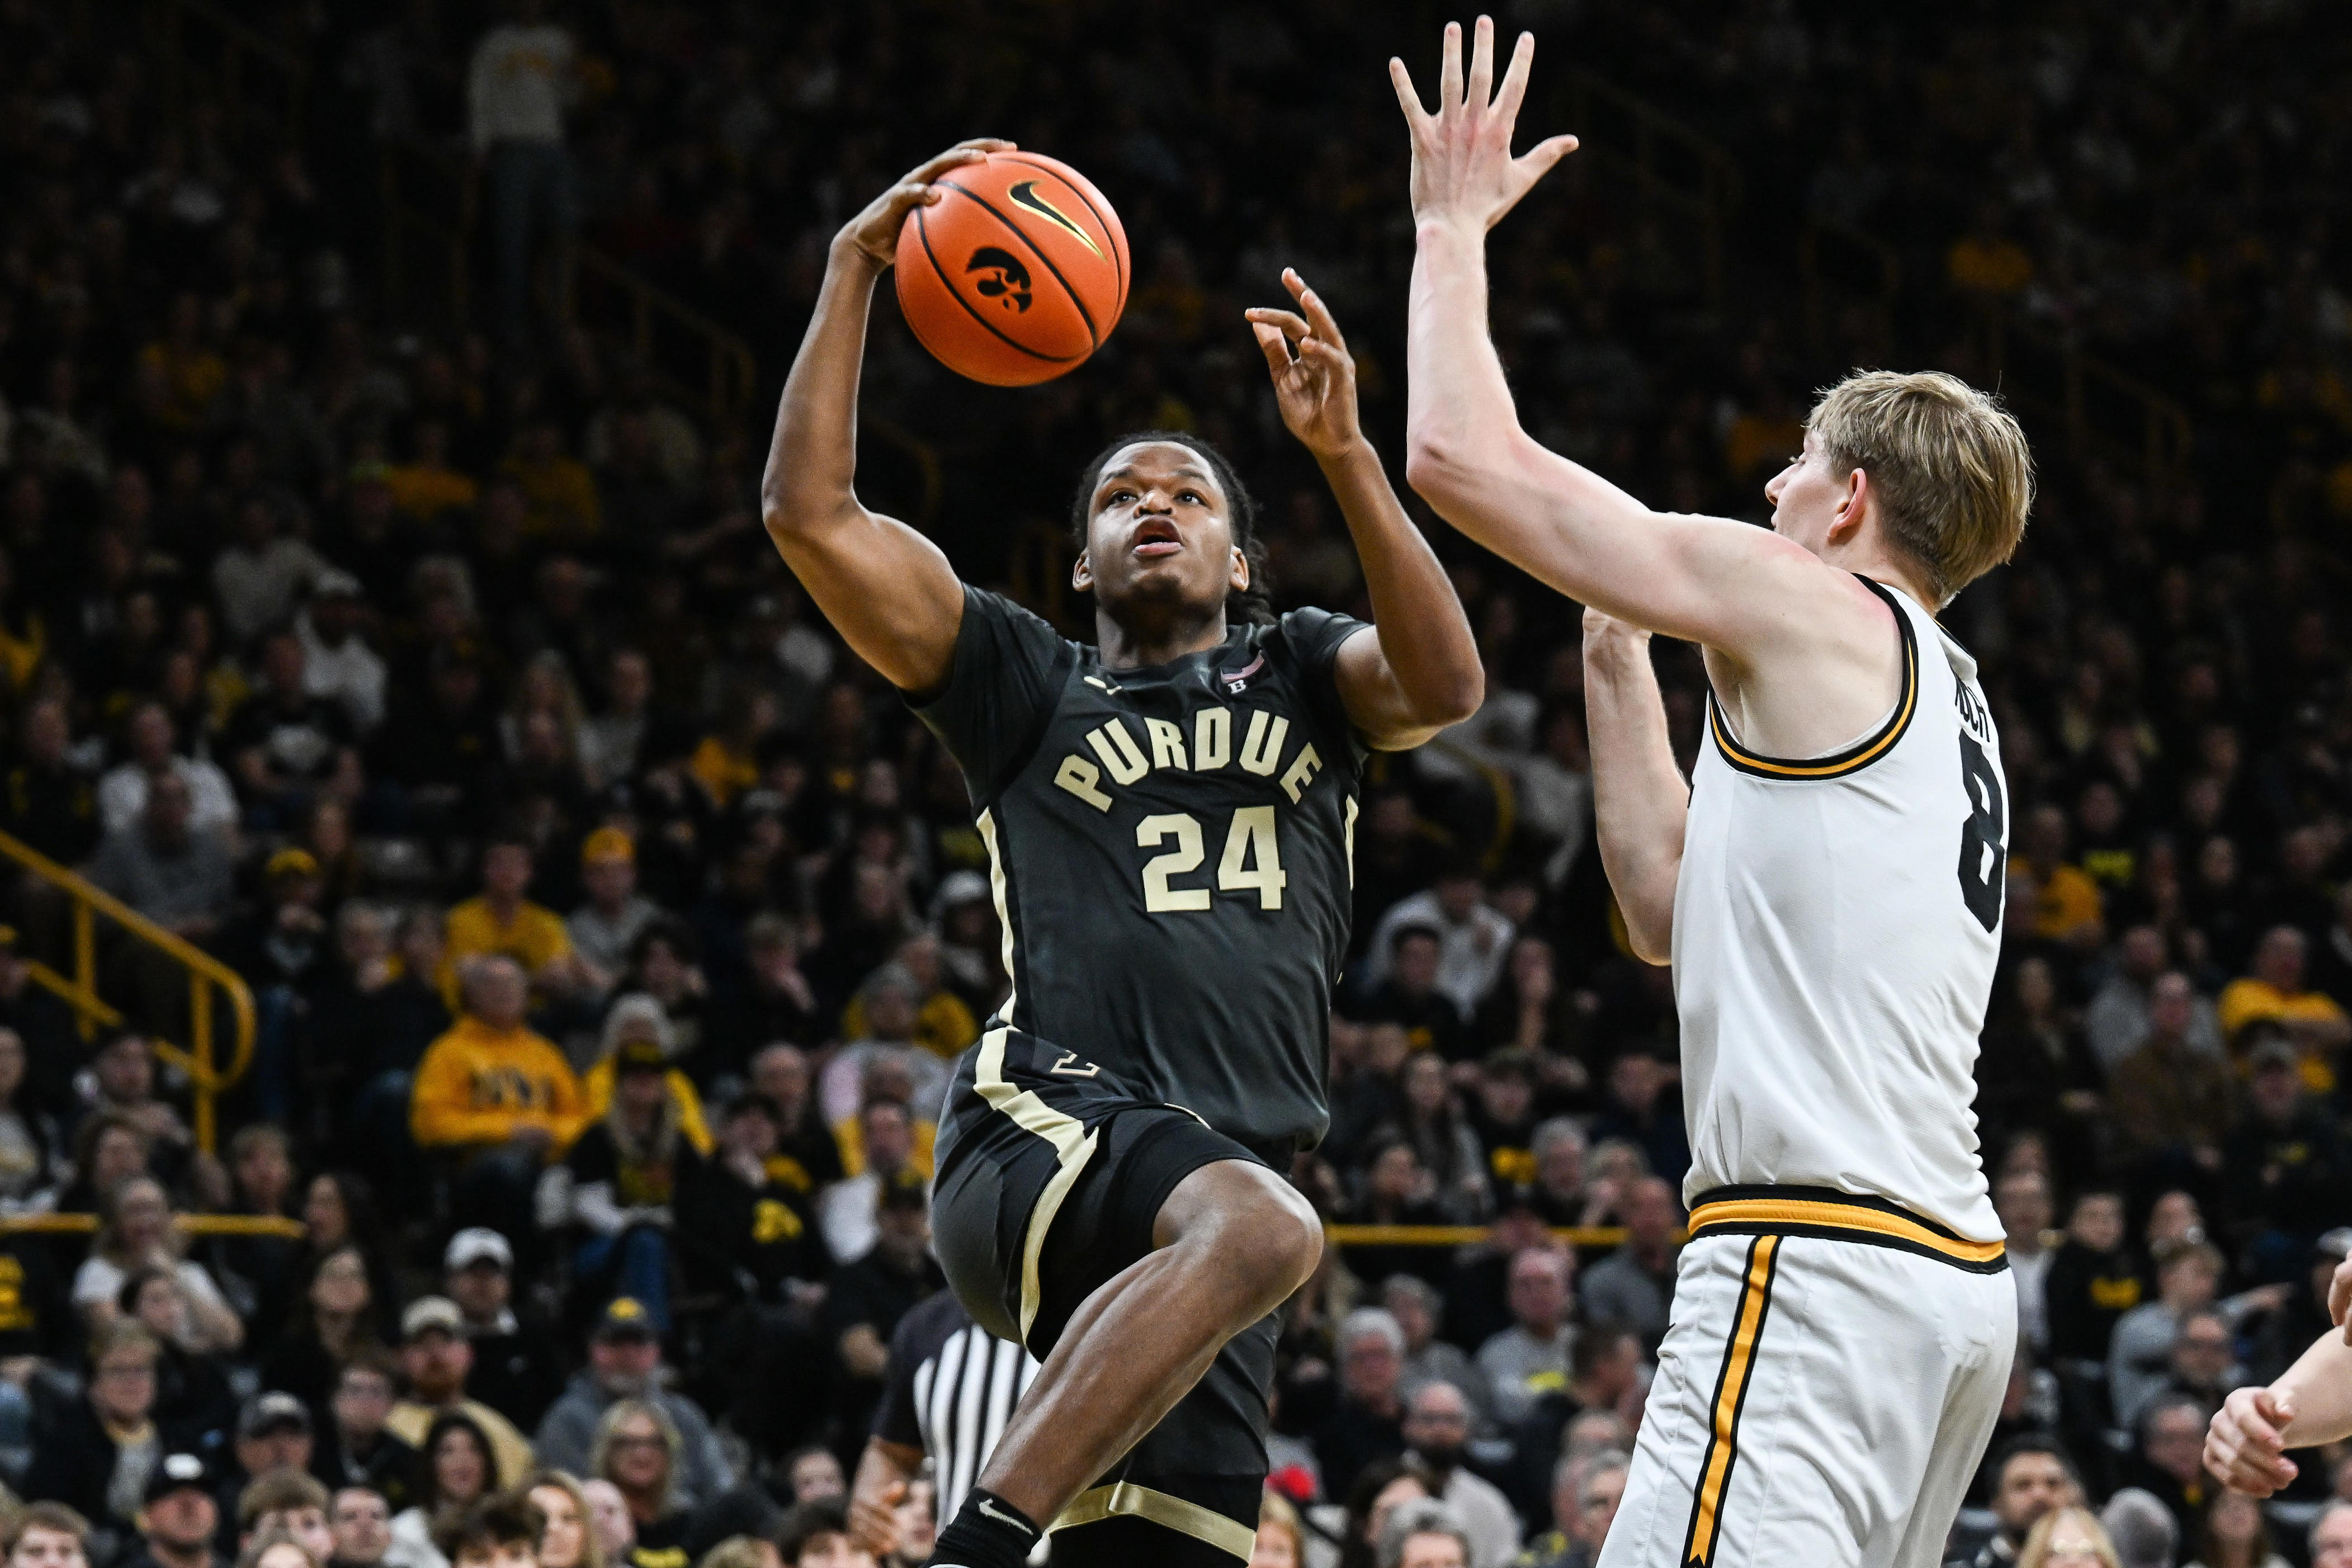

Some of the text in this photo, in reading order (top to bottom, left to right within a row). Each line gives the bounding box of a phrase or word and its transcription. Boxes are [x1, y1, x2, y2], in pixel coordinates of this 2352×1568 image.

[1227, 679, 1246, 694] B
[1054, 706, 1323, 813] PURDUE
[1136, 805, 1286, 913] 24
[1958, 728, 2005, 933] 8
